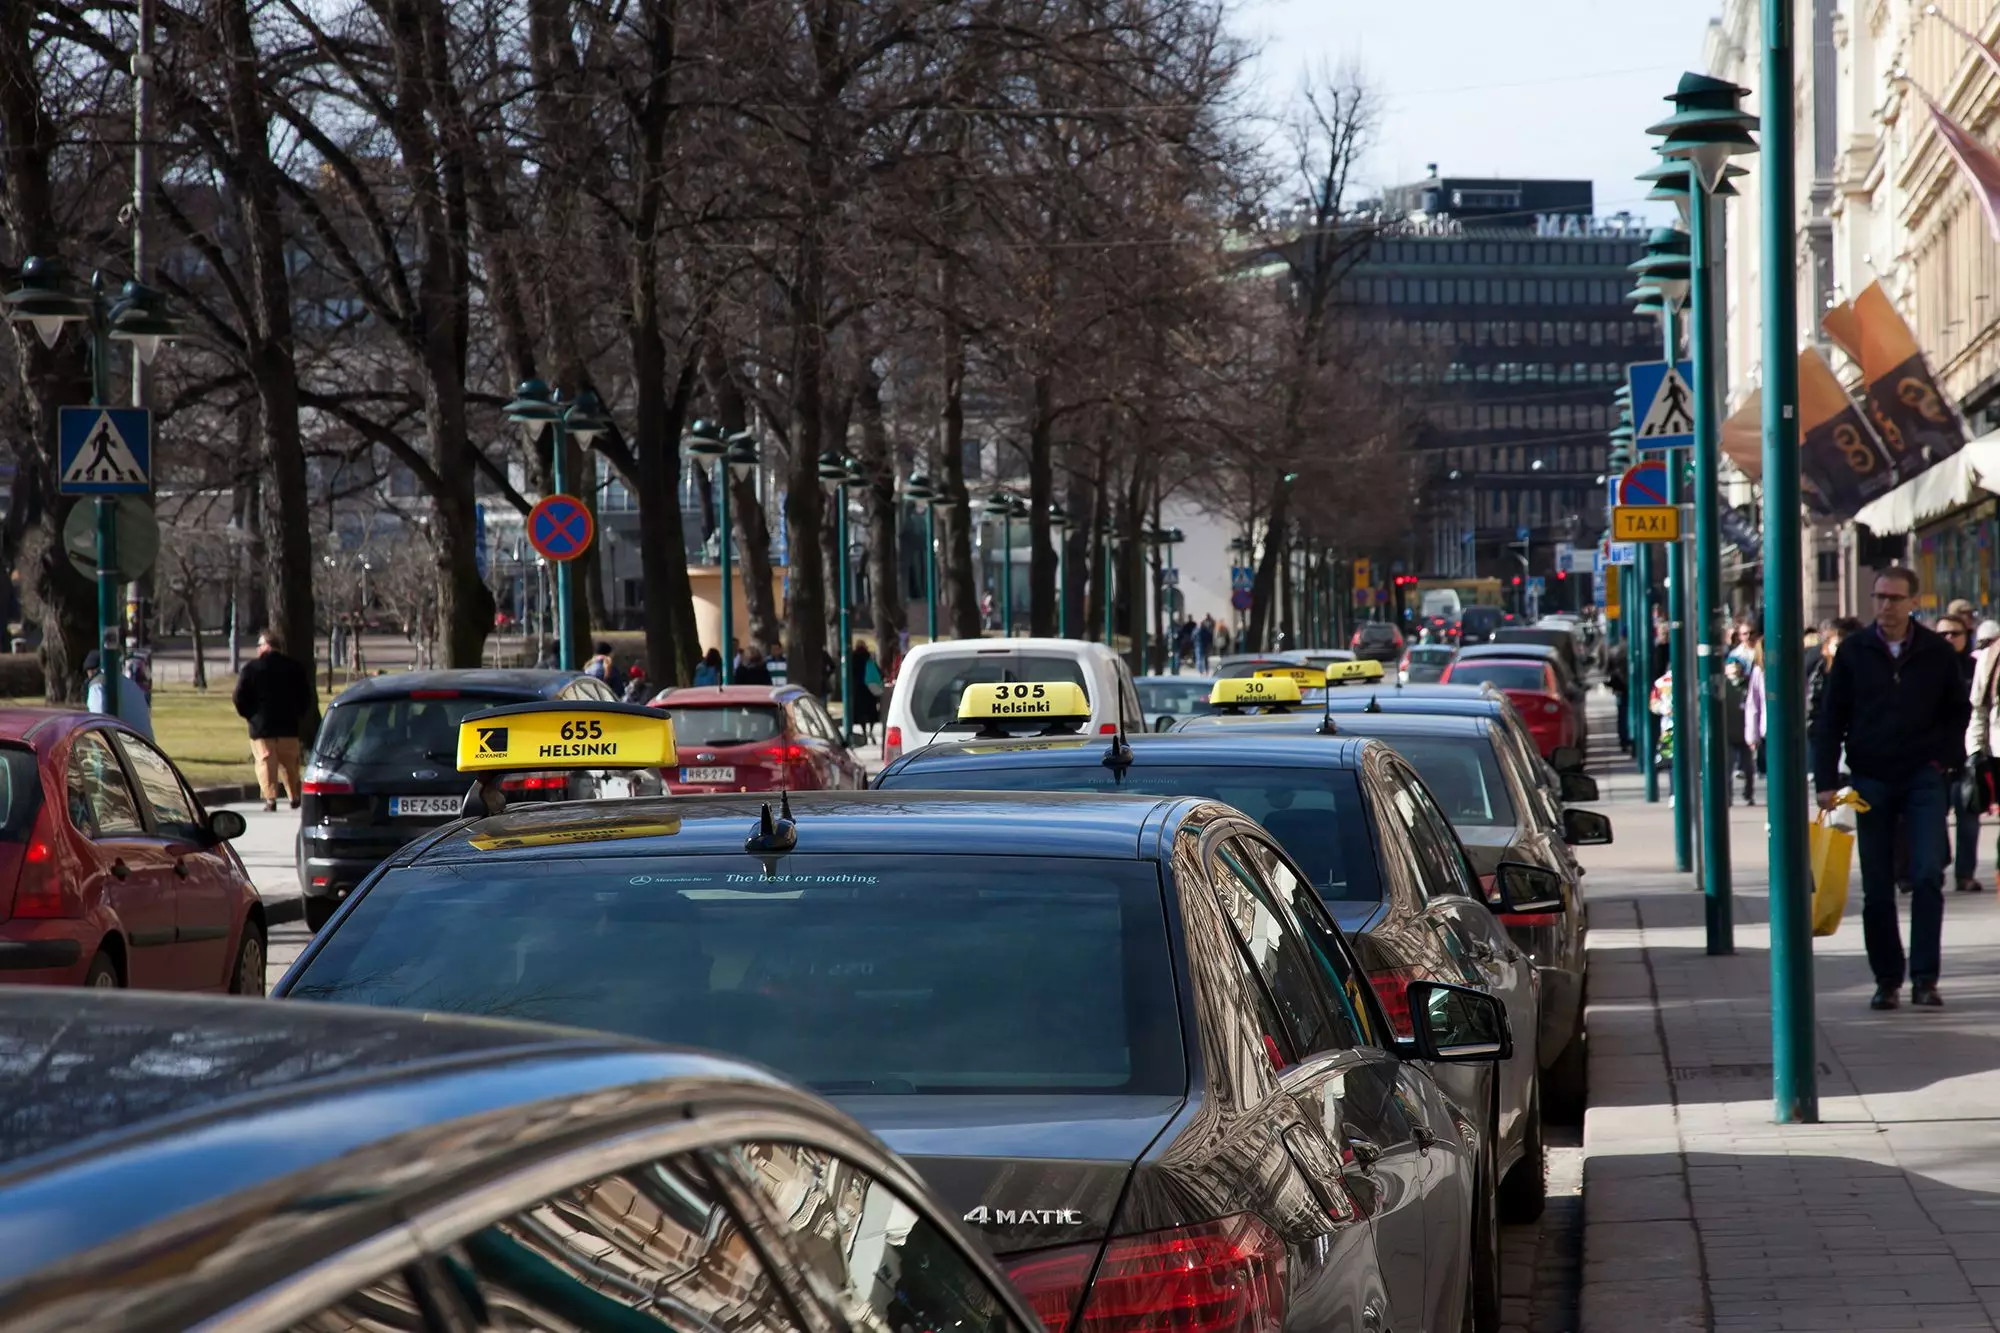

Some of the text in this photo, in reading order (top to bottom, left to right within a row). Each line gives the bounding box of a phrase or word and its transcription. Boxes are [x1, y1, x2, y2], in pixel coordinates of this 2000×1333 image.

[1625, 515, 1666, 532] TAXI
[995, 684, 1045, 700] 305
[1245, 682, 1264, 693] 30
[992, 701, 1050, 714] Helsinki
[560, 720, 602, 741] 655
[539, 742, 617, 757] HELSINKI
[401, 799, 458, 813] BEZ-558
[726, 874, 753, 883] The
[758, 873, 790, 883] best
[795, 875, 812, 883] or
[816, 874, 880, 885] nothing.
